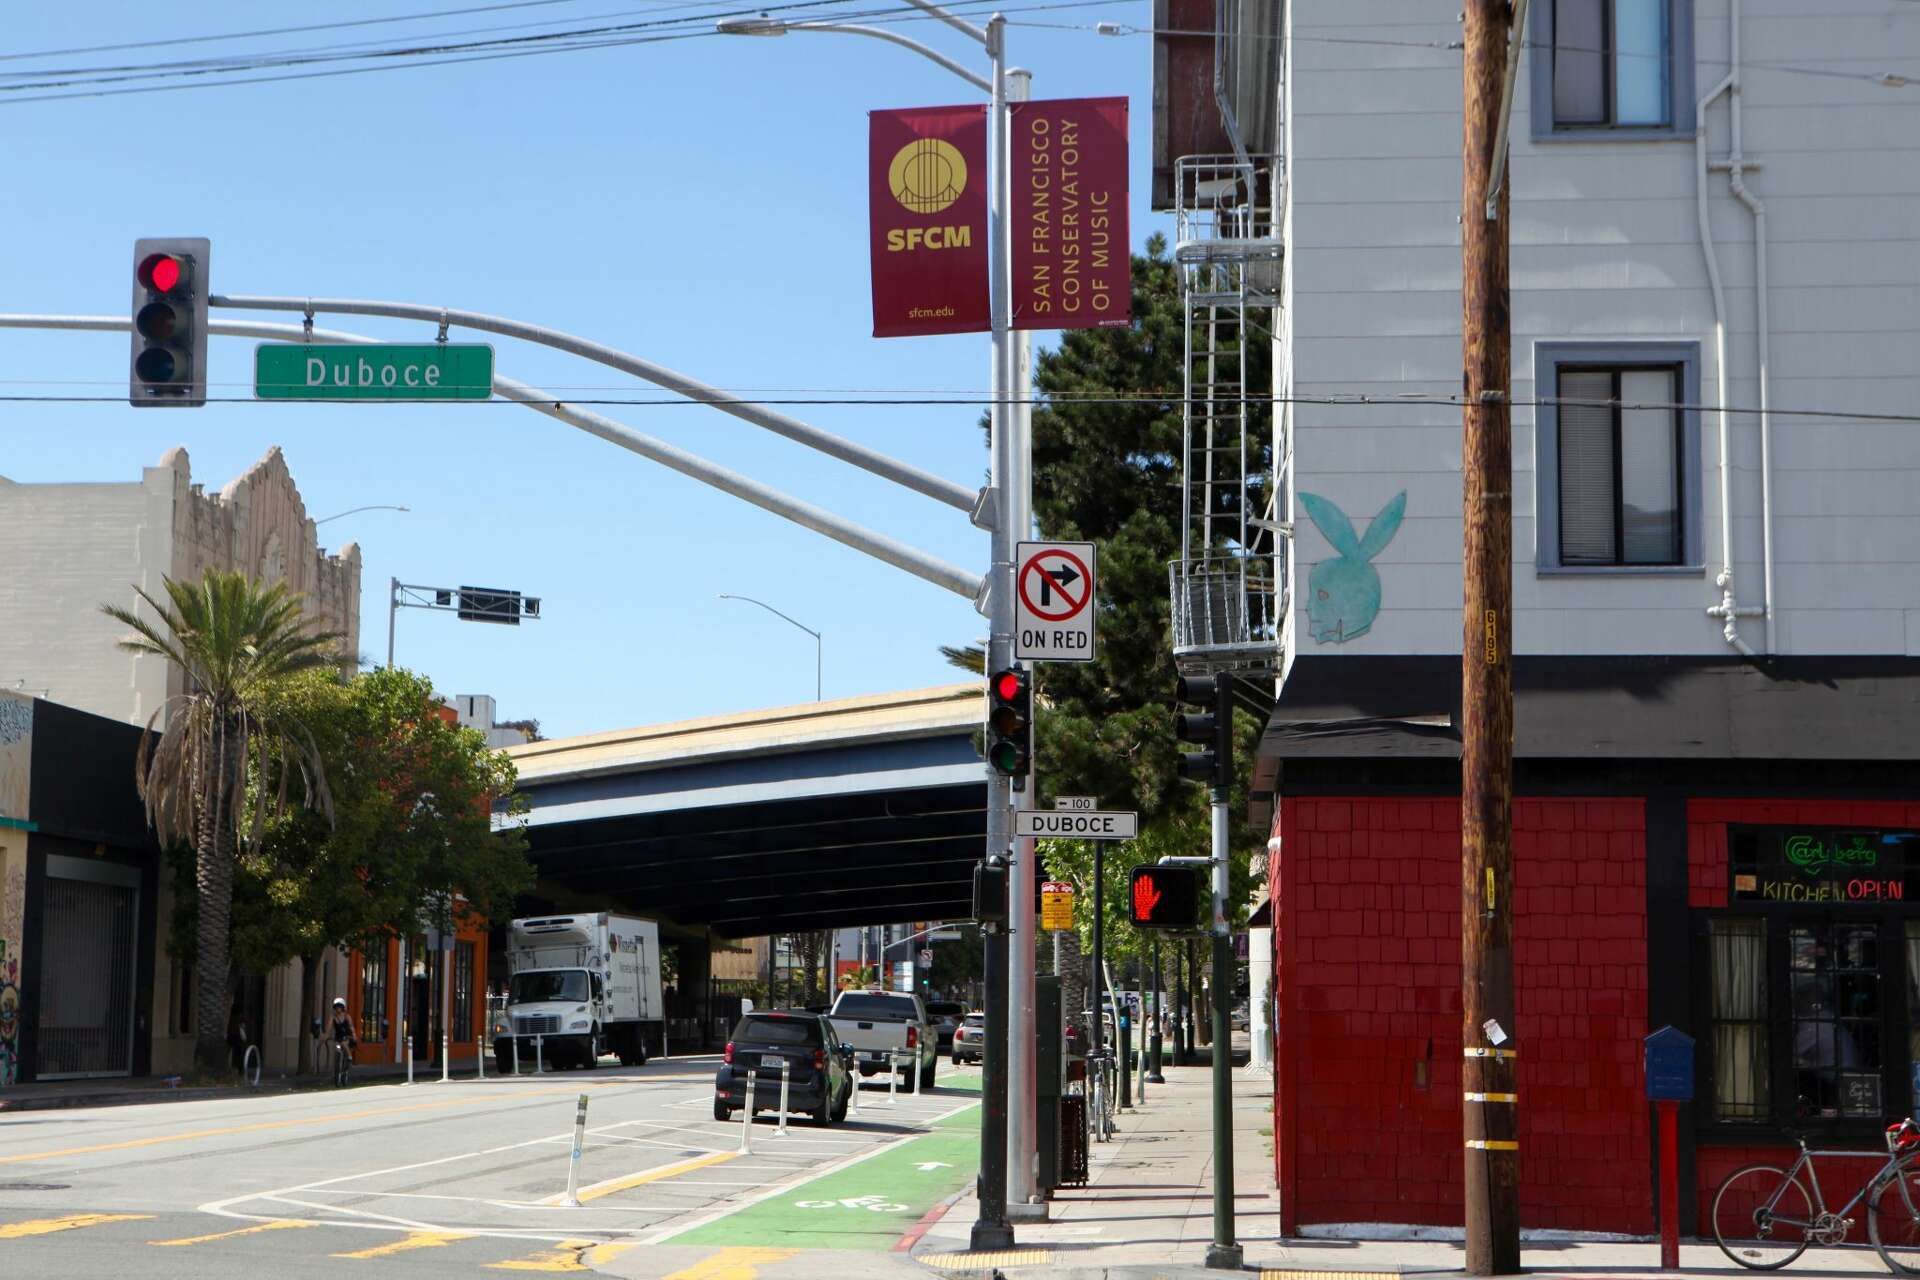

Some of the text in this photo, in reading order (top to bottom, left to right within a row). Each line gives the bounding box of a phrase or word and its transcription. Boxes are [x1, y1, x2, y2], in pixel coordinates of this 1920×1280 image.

[1031, 118, 1050, 313] SAN FRANCISCO
[1060, 119, 1080, 312] CONSERVATORY
[887, 225, 971, 252] SFCM
[1090, 191, 1110, 311] OF MUSIC
[908, 305, 954, 318] sfcm.edu
[306, 357, 441, 387] Duboce
[1022, 630, 1087, 649] ON RED
[1487, 611, 1495, 663] 6195
[1072, 799, 1090, 809] 100
[1032, 816, 1114, 833] DUBOCE
[1763, 879, 1903, 902] KITCHEN OPEN
